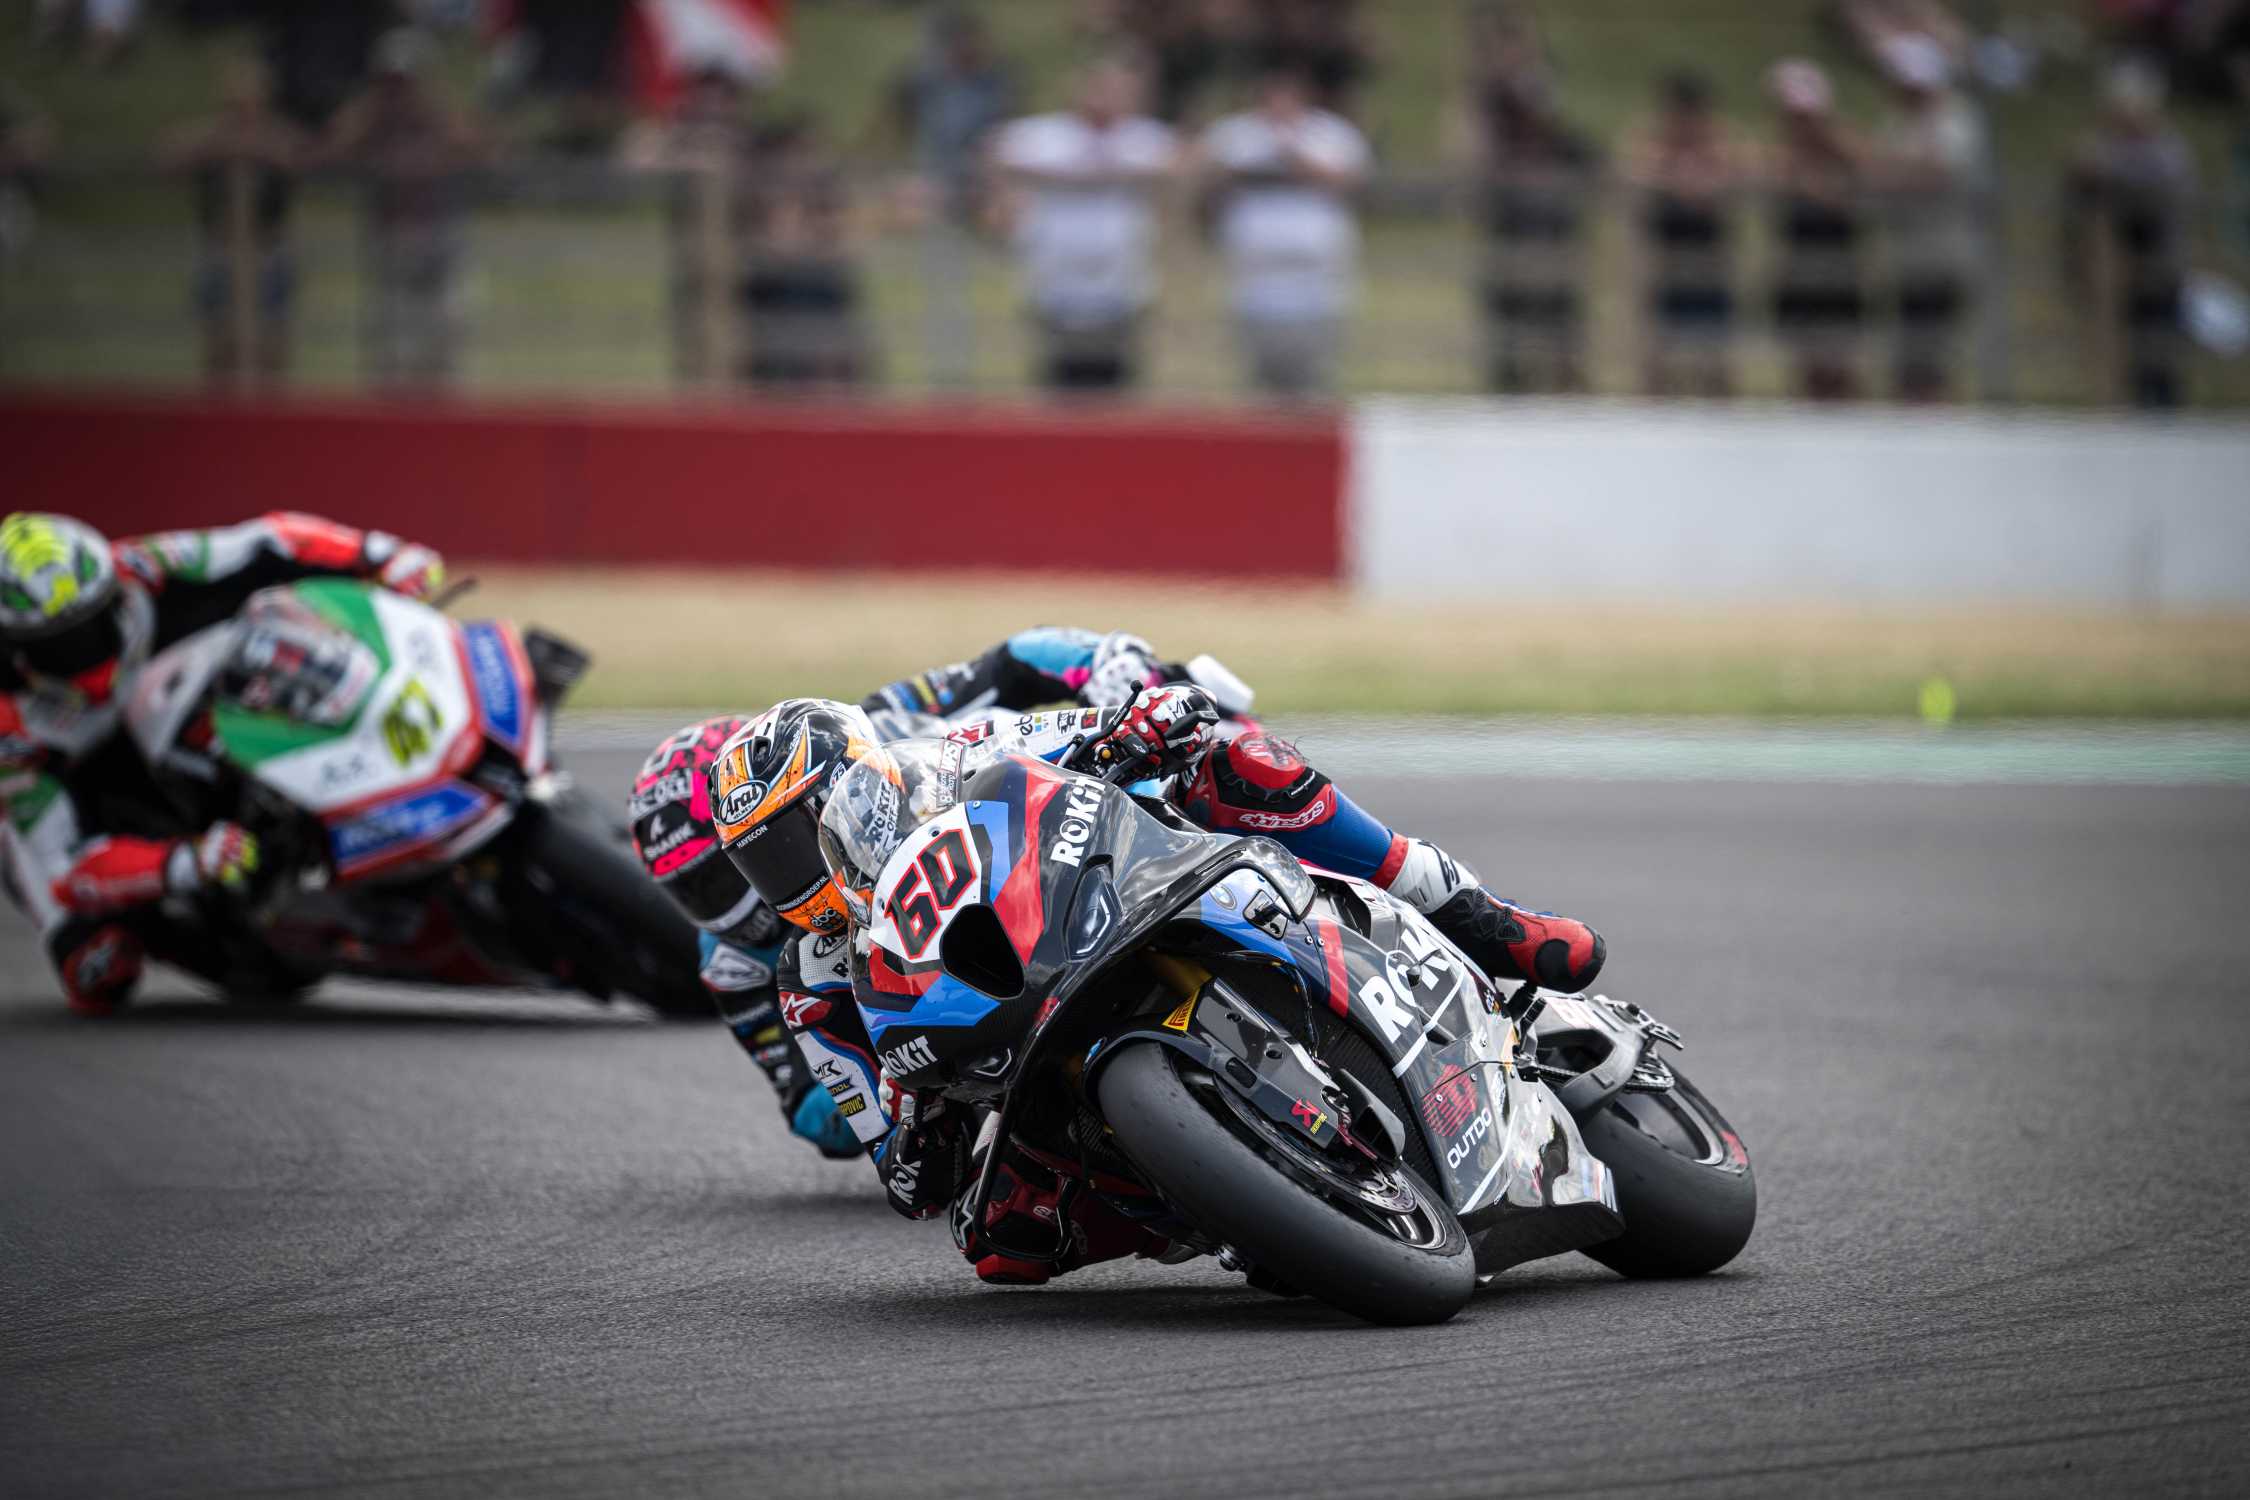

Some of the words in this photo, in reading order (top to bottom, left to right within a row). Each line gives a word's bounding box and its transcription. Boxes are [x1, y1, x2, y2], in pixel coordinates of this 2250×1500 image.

[723, 783, 760, 822] Arai
[1050, 776, 1106, 868] ROKiT
[883, 828, 978, 960] 60
